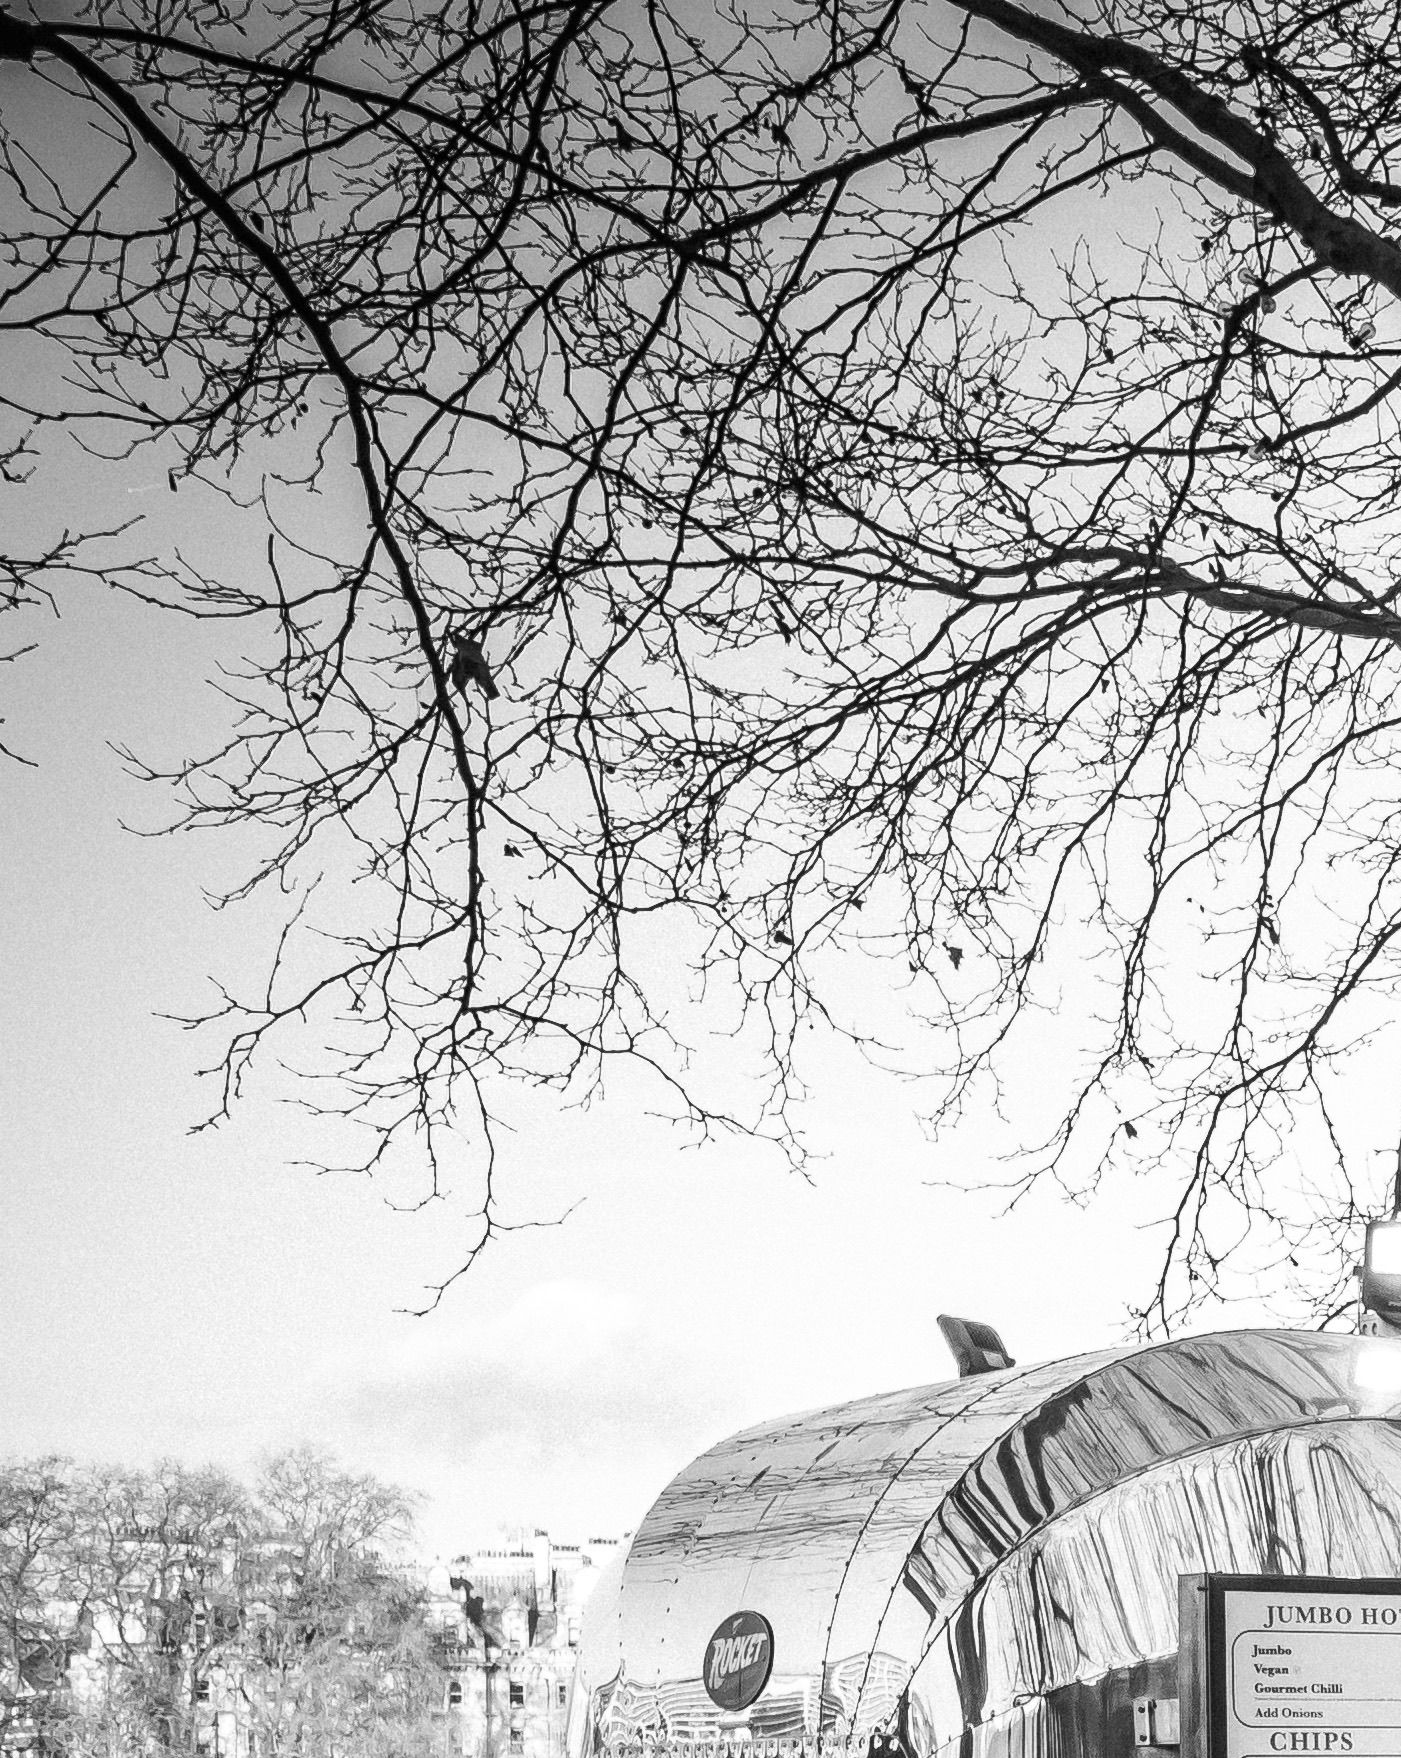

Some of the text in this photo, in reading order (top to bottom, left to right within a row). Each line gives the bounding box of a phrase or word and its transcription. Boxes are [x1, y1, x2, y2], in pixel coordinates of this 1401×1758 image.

[1263, 1605, 1352, 1630] JUMBO
[1251, 1644, 1292, 1658] Jumbo
[709, 1633, 767, 1689] ROCKET
[1253, 1664, 1289, 1676] Vegan
[1254, 1683, 1343, 1695] Gourmet Chilli
[1254, 1708, 1323, 1719] Add Onions
[1269, 1732, 1353, 1751] CHIPS
